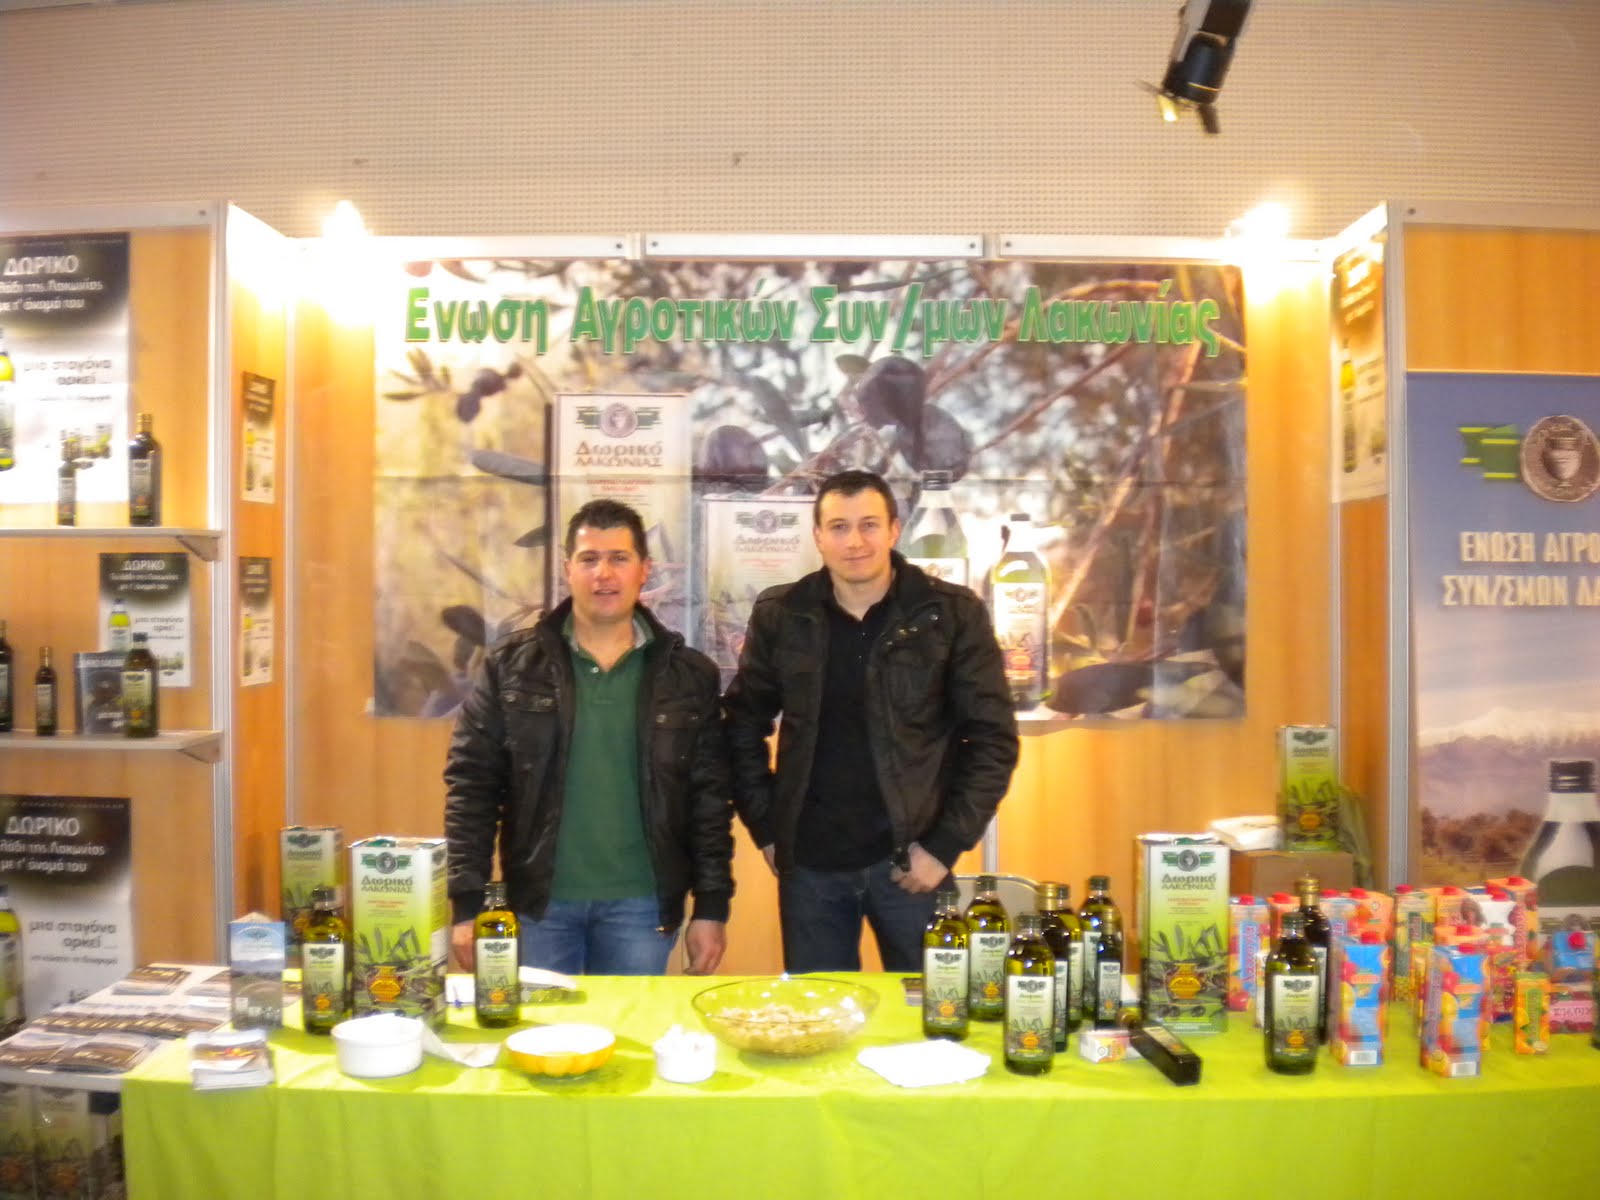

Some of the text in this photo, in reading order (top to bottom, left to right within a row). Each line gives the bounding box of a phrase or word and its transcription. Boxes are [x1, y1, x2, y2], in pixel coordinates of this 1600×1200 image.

[3, 254, 80, 276] ΔΩΡΙΚΟ
[404, 278, 1221, 358] Ενωση Αγροτικών Συν/μων Λακωνίας
[575, 440, 663, 456] Δωρικό
[1459, 531, 1536, 563] ΕΝΩΣΗ
[121, 559, 166, 571] ΔΩΡΙΚΟ
[1442, 574, 1569, 607] ΣΥΝ/ΣΜΩΝ
[5, 815, 80, 836] ΔΩΡΙΚΟ
[50, 841, 106, 856] Λακωνίας
[66, 863, 88, 873] του
[361, 875, 414, 887] Δωρικό
[1161, 872, 1218, 884] Δωρικό
[360, 885, 414, 894] ΛΑΚΩΝΙΑΣ
[29, 919, 118, 936] μια σταγόνα
